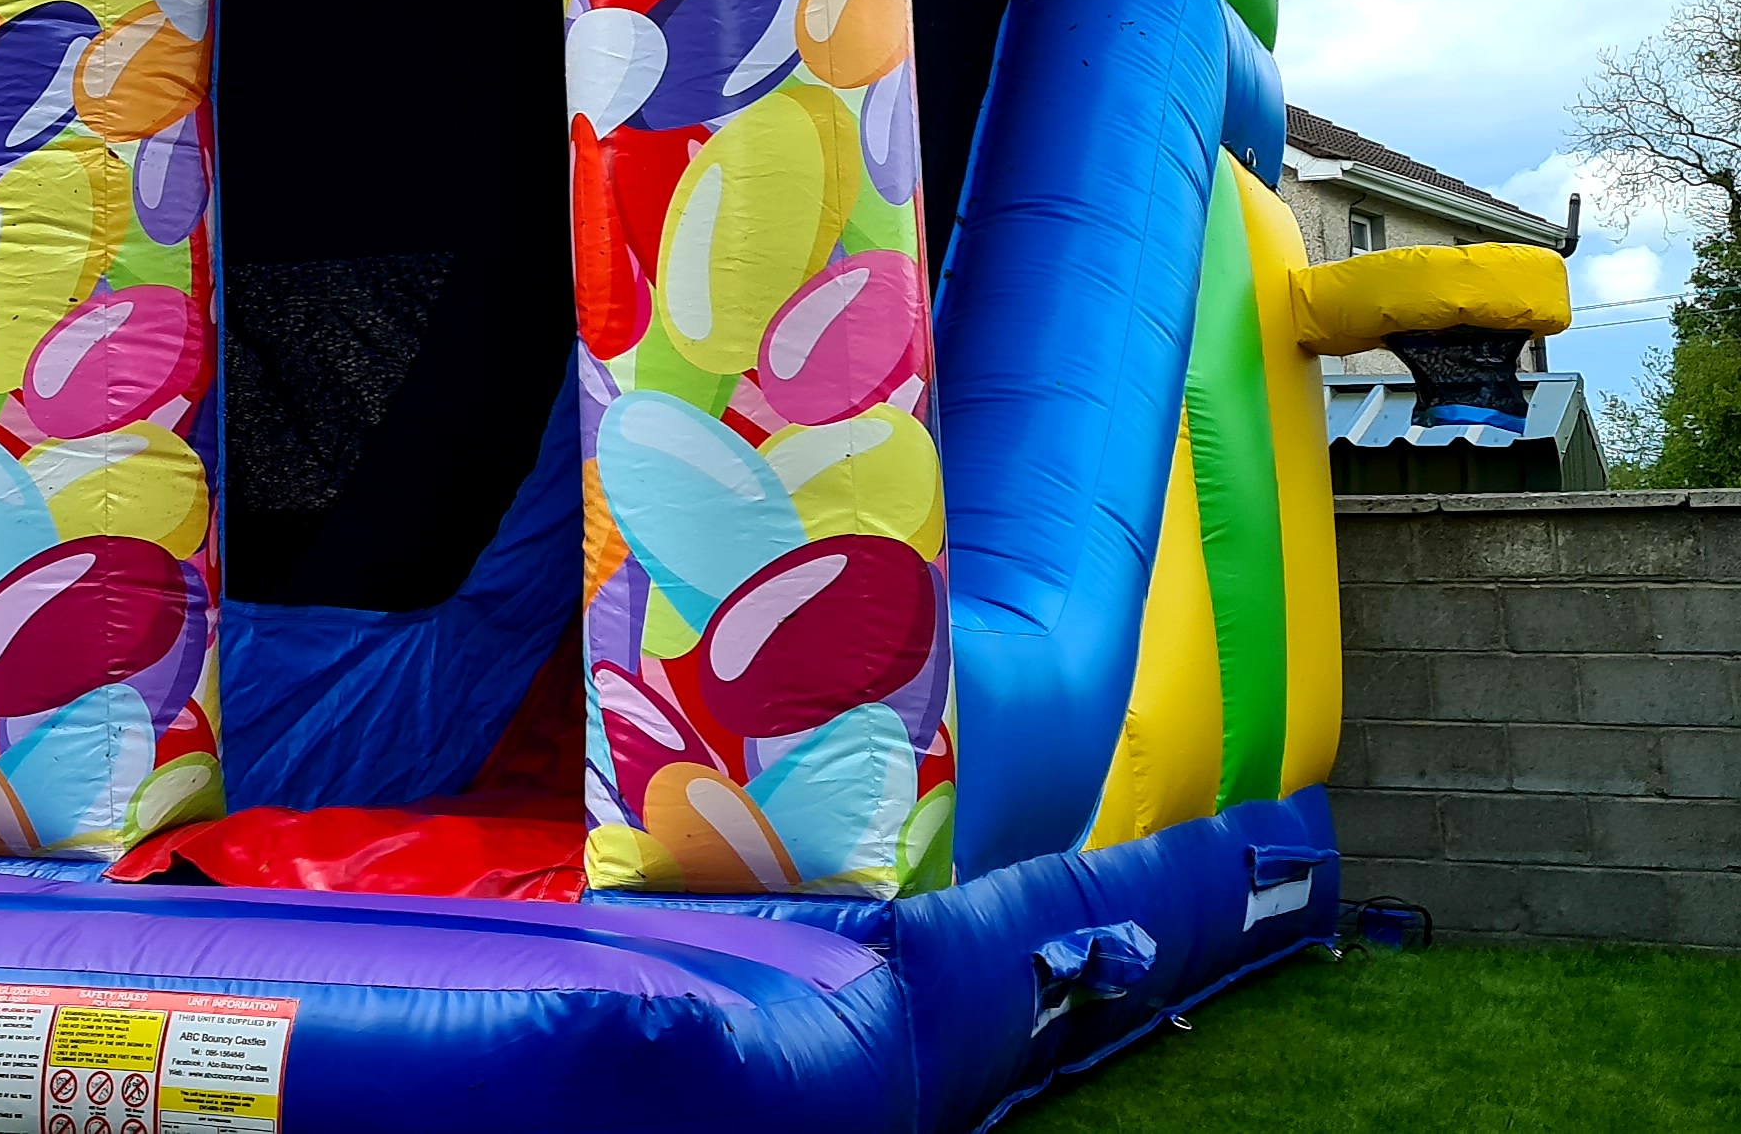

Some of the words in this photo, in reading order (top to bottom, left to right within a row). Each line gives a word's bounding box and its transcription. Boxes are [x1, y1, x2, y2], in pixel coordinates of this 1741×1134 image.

[79, 989, 115, 1000] SAFETY
[117, 991, 149, 1002] RULES
[187, 997, 210, 1007] UNIT
[211, 999, 278, 1012] INFORMATION
[178, 1013, 196, 1022] THIS
[197, 1015, 215, 1023] UNIT
[217, 1016, 225, 1024] IS
[226, 1017, 265, 1027] SUPPLIED
[179, 1031, 200, 1042] ABC
[201, 1033, 233, 1046] Bouncy
[235, 1035, 267, 1046] Castles
